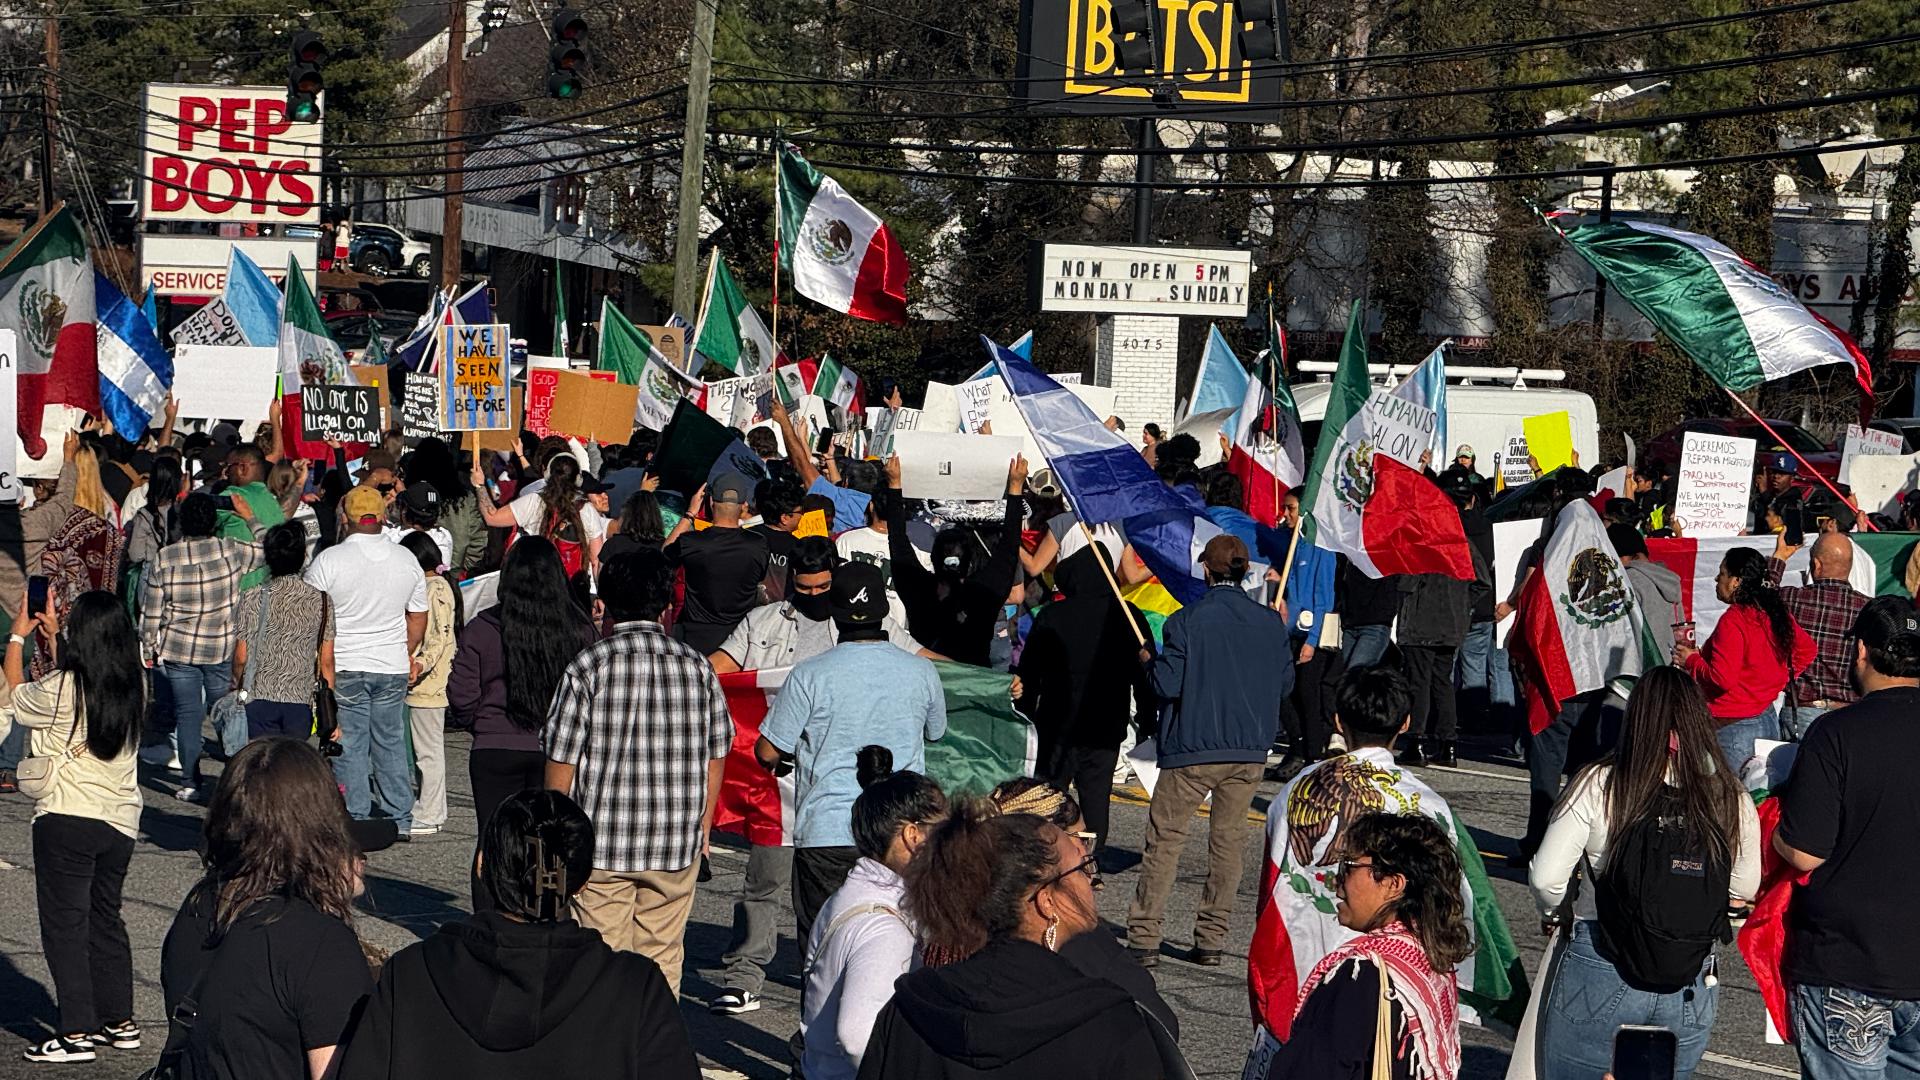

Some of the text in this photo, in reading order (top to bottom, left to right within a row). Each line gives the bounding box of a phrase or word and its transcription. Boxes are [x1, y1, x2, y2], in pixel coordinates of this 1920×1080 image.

[1085, 0, 1233, 82] BTSI
[178, 96, 293, 154] PEP
[152, 157, 314, 216] BOYS
[469, 210, 499, 233] PARTS
[1061, 261, 1229, 281] NOW OPEN 5PM
[154, 272, 225, 290] SERVICE
[1055, 282, 1243, 303] MONDAY SUNDAY
[459, 329, 491, 343] WE
[458, 345, 496, 358] HAVE
[1123, 339, 1162, 350] 4075
[457, 363, 499, 377] SEEN
[534, 374, 556, 385] GOD
[460, 382, 492, 395] THIS
[963, 380, 992, 399] What
[303, 387, 323, 411] NO
[356, 391, 368, 414] IS
[455, 399, 505, 412] BEFORE
[532, 408, 546, 419] HIS
[642, 404, 671, 424] MEXIC
[1373, 393, 1437, 434] HUMAN IS
[1392, 433, 1417, 461] ON
[1510, 446, 1529, 456] UNID
[1687, 439, 1736, 454] QUEREMOS
[1679, 491, 1720, 501] WE WANT
[1687, 507, 1726, 518] STOP
